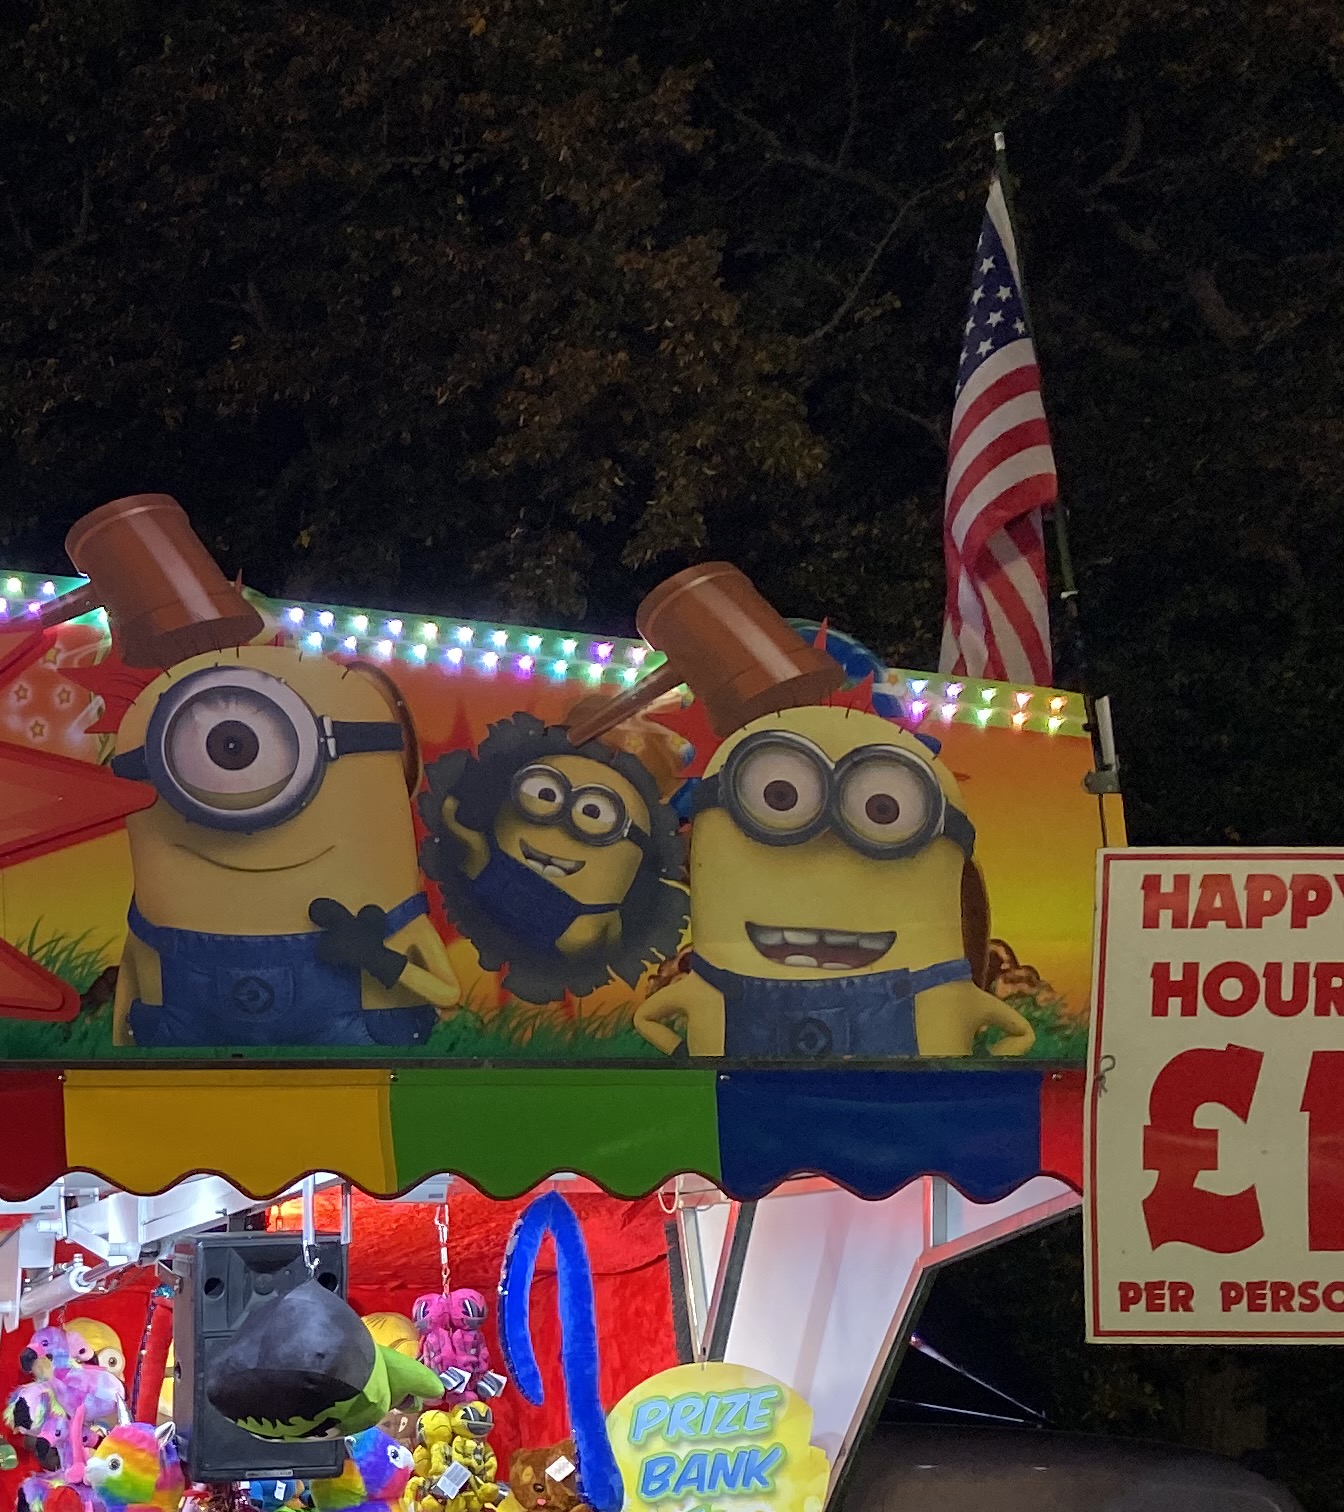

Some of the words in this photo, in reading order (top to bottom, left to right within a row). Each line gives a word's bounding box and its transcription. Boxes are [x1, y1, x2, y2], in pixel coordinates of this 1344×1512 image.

[1150, 961, 1344, 1018] HOUR
[1142, 1043, 1344, 1255] £1
[1118, 1280, 1195, 1313] PER
[631, 1388, 781, 1444] PRIZE
[640, 1446, 784, 1498] BANK
